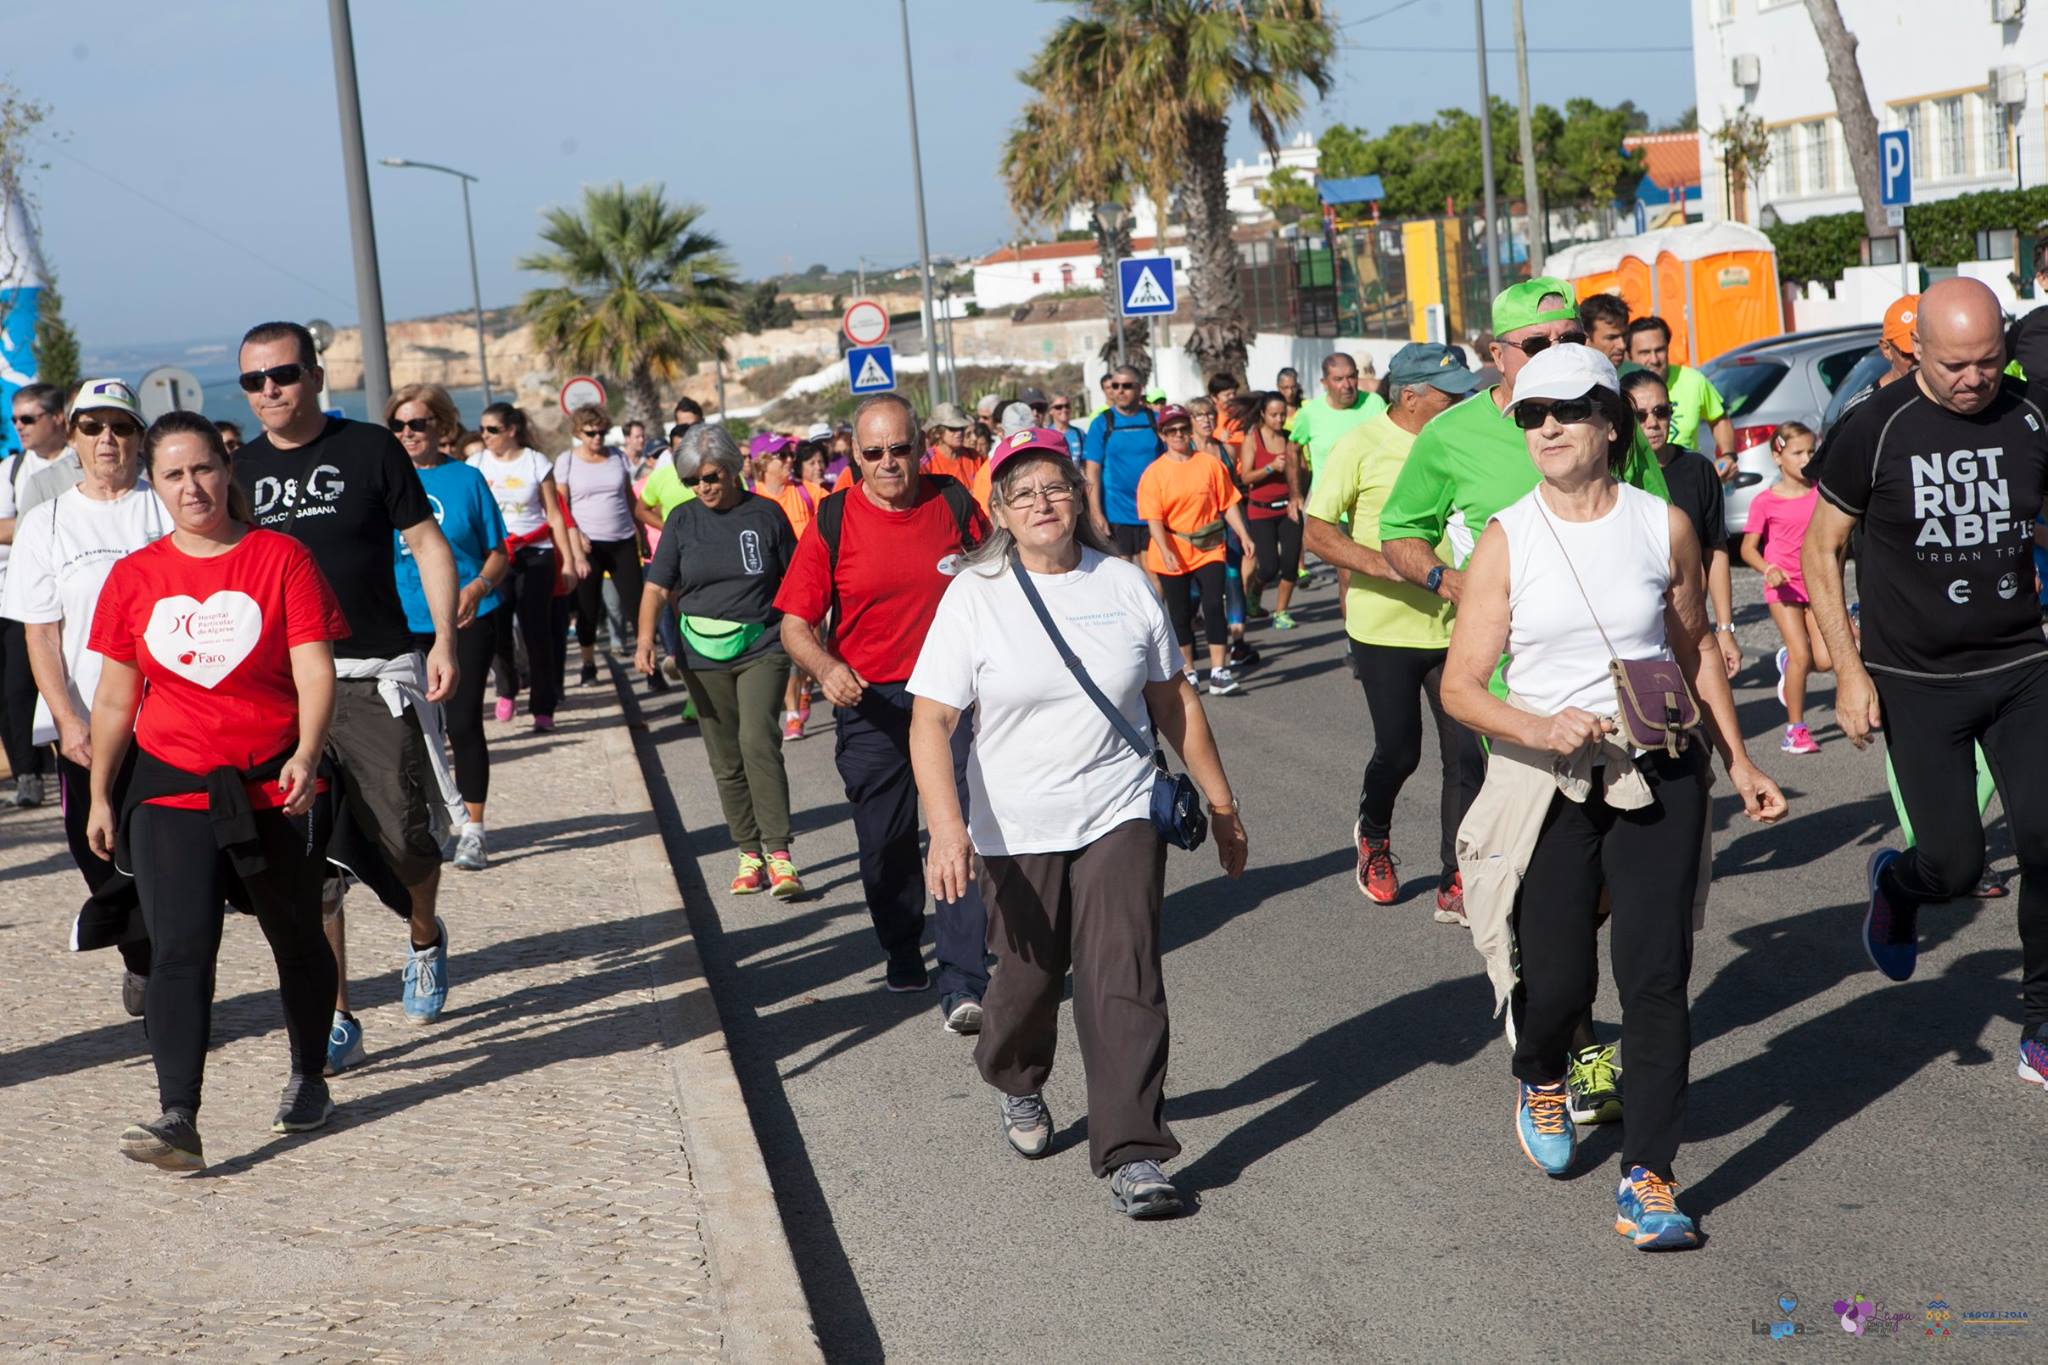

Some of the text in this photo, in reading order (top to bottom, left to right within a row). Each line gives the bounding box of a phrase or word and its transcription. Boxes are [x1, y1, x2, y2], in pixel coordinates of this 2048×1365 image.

[1885, 137, 1904, 199] P
[1911, 447, 2004, 487] NGT
[1914, 479, 2010, 519] RUN
[1915, 511, 2011, 547] ABF
[1916, 551, 1982, 563] URBAN
[198, 612, 229, 621] Hospital
[198, 620, 234, 629] Particular
[208, 626, 235, 634] Algarve
[199, 652, 226, 664] Faro
